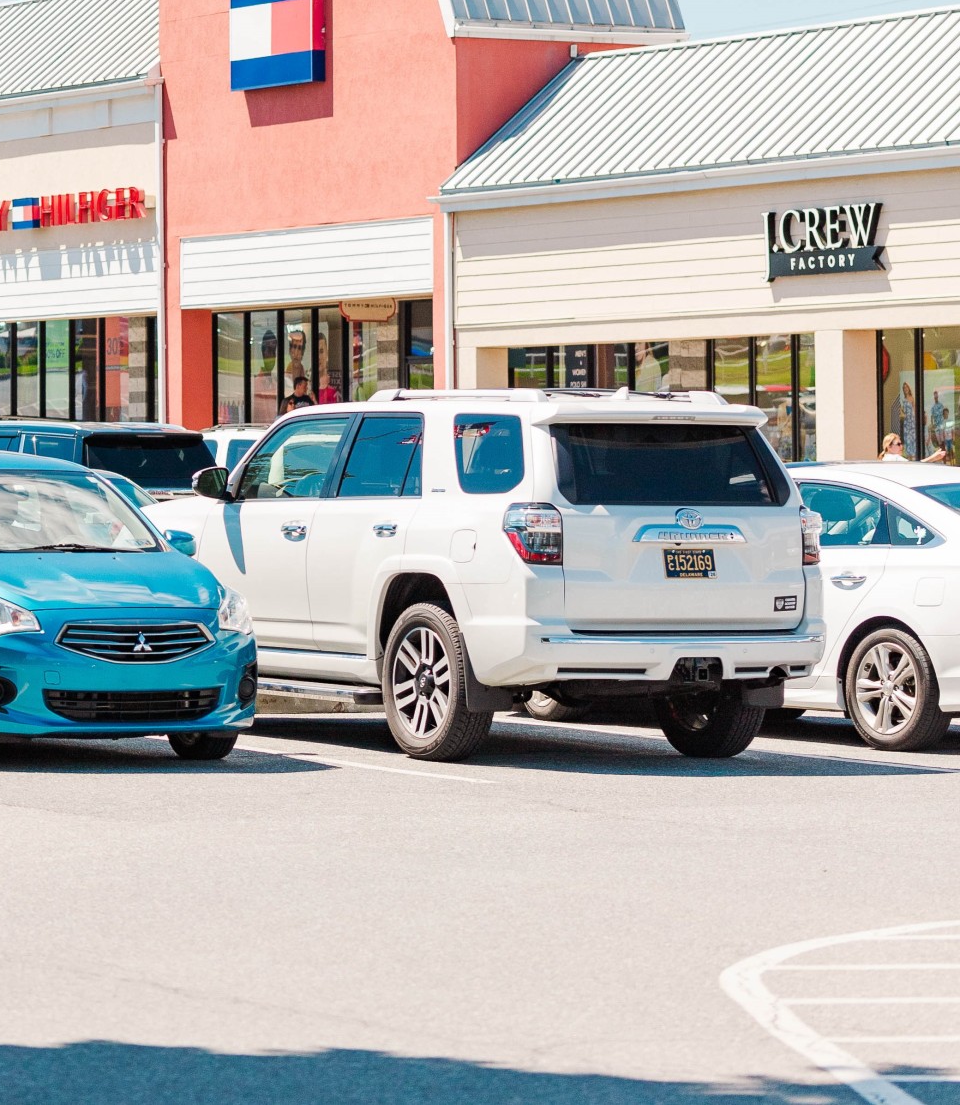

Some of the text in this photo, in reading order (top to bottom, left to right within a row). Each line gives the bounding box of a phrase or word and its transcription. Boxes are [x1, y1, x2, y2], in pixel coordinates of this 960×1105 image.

[41, 186, 147, 227] HILFIGER
[761, 203, 882, 282] J.CREW
[790, 254, 855, 270] FACTORY
